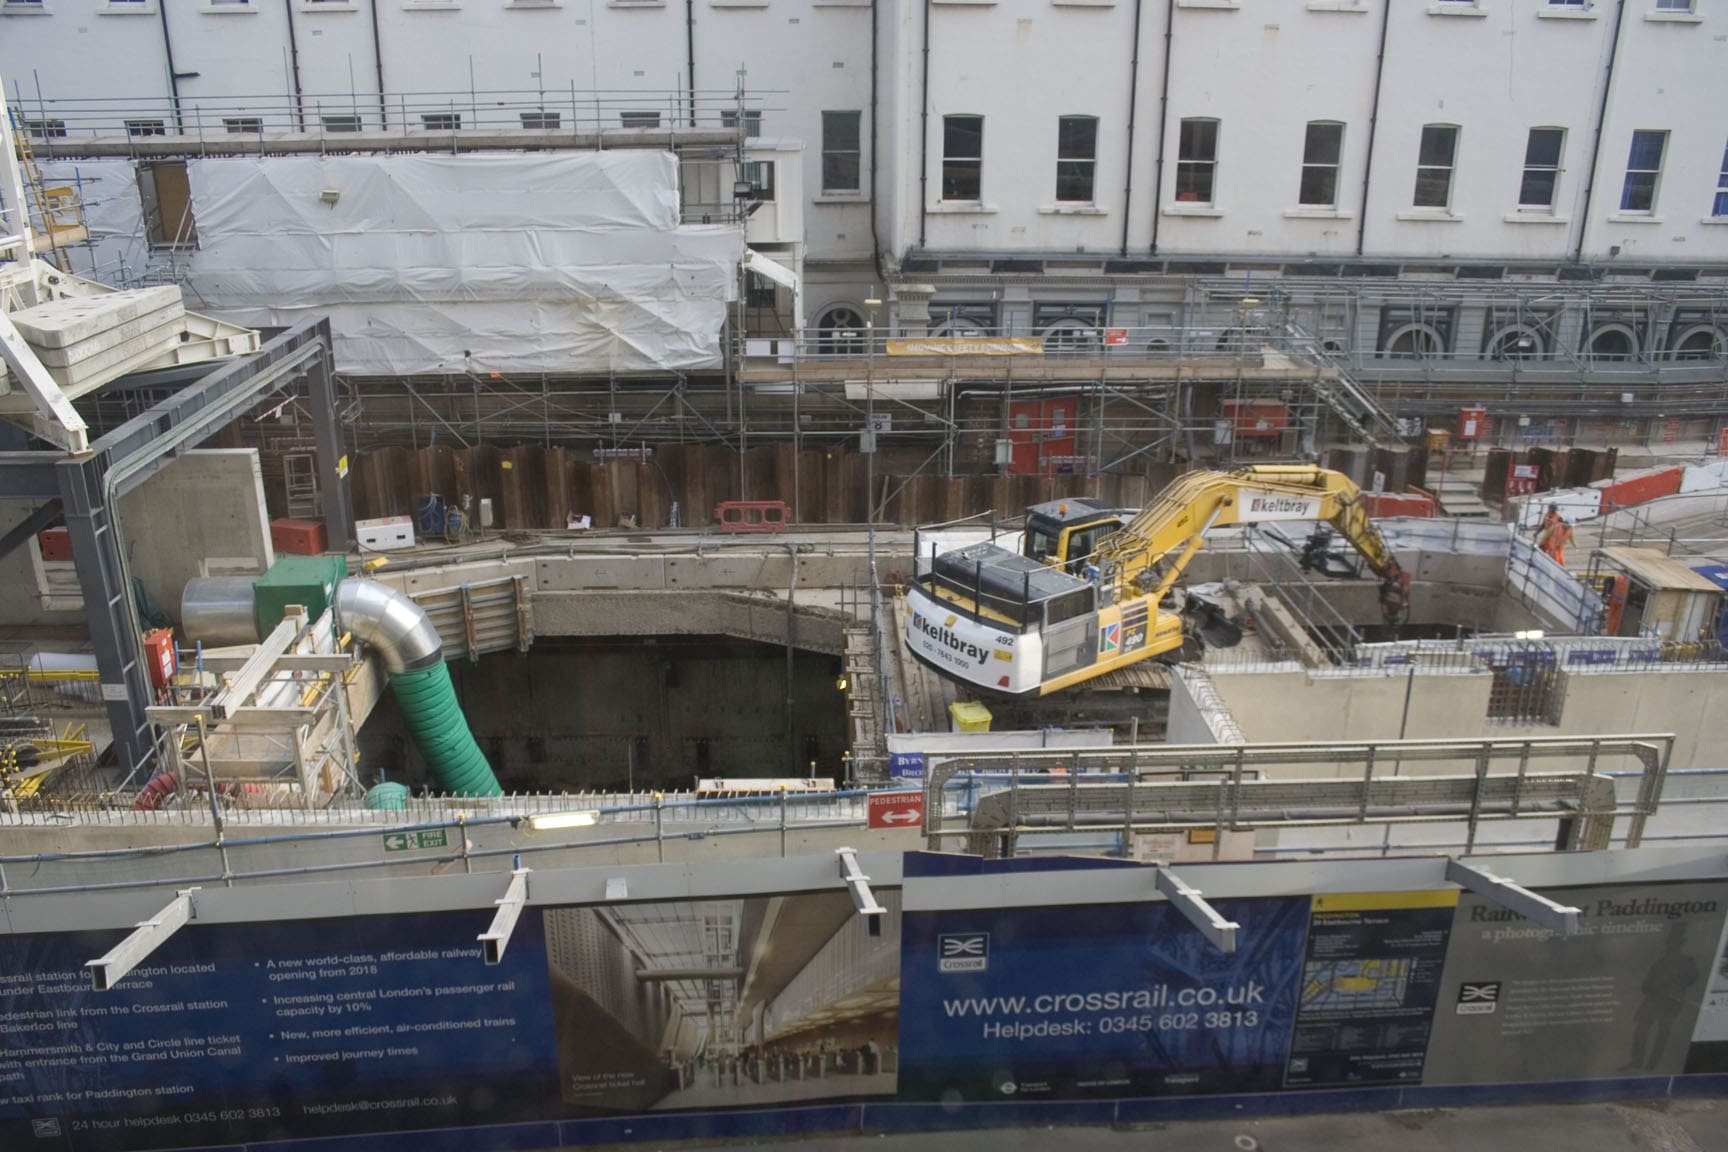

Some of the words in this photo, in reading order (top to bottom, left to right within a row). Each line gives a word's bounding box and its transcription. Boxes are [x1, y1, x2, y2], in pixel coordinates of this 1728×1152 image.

[1261, 499, 1309, 515] keltbray
[922, 617, 989, 665] keltbray
[995, 635, 1014, 646] 492
[422, 830, 442, 840] FIRE
[423, 839, 442, 848] EXIT
[1596, 899, 1717, 920] Paddington
[1481, 929, 1492, 939] a
[1600, 919, 1664, 933] timeline
[266, 959, 276, 968] A
[278, 960, 303, 968] new
[305, 953, 378, 966] world-class,
[380, 949, 439, 962] affordable
[441, 947, 482, 960] railway
[943, 959, 983, 970] Crossrail
[36, 971, 76, 982] station
[171, 963, 216, 975] located
[269, 969, 316, 982] opening
[319, 967, 346, 977] from
[349, 965, 378, 976] 2018
[0, 986, 34, 997] under
[274, 990, 334, 1005] Increasing
[336, 989, 376, 1001] central
[435, 983, 494, 997] passenger
[497, 981, 515, 991] rail
[943, 981, 1265, 1018] www.crossrail.co.uk
[56, 1008, 78, 1018] link
[80, 1007, 107, 1016] from
[110, 1005, 129, 1014] the
[132, 1002, 184, 1013] Crossrail
[187, 1000, 228, 1010] station
[276, 1006, 326, 1018] capacity
[328, 1003, 342, 1015] by
[345, 1002, 372, 1012] 10%
[0, 1022, 54, 1033] Bakerloo
[57, 1020, 78, 1030] line
[280, 1030, 310, 1040] New,
[312, 1029, 342, 1038] more
[396, 1019, 481, 1033] air-conditioned
[483, 1017, 516, 1027] trains
[983, 1019, 1091, 1040] Helpdesk:
[1099, 1017, 1152, 1034] 0345
[1159, 1014, 1198, 1030] 602
[1204, 1011, 1258, 1029] 3813
[96, 1042, 120, 1052] City
[123, 1039, 145, 1050] and
[147, 1037, 181, 1049] Circle
[184, 1036, 204, 1046] line
[207, 1034, 241, 1045] ticket
[25, 1057, 77, 1068] entrance
[80, 1055, 107, 1065] from
[110, 1054, 128, 1063] the
[131, 1050, 167, 1062] Grand
[170, 1048, 204, 1059] Union
[207, 1046, 241, 1056] Canal
[285, 1051, 339, 1065] Improved
[342, 1049, 384, 1061] journey
[387, 1047, 418, 1057] times
[12, 1094, 34, 1104] taxi
[37, 1093, 62, 1102] rank
[66, 1091, 82, 1100] for
[85, 1087, 152, 1099] Paddington
[155, 1085, 194, 1096] station
[303, 1095, 458, 1115] helpdesk@crossrail.co.uk
[72, 1120, 88, 1131] 24
[92, 1118, 120, 1129] hour
[124, 1113, 180, 1128] helpdesk
[184, 1111, 217, 1123] 0345
[220, 1109, 245, 1121] 602
[248, 1107, 281, 1118] 3813
